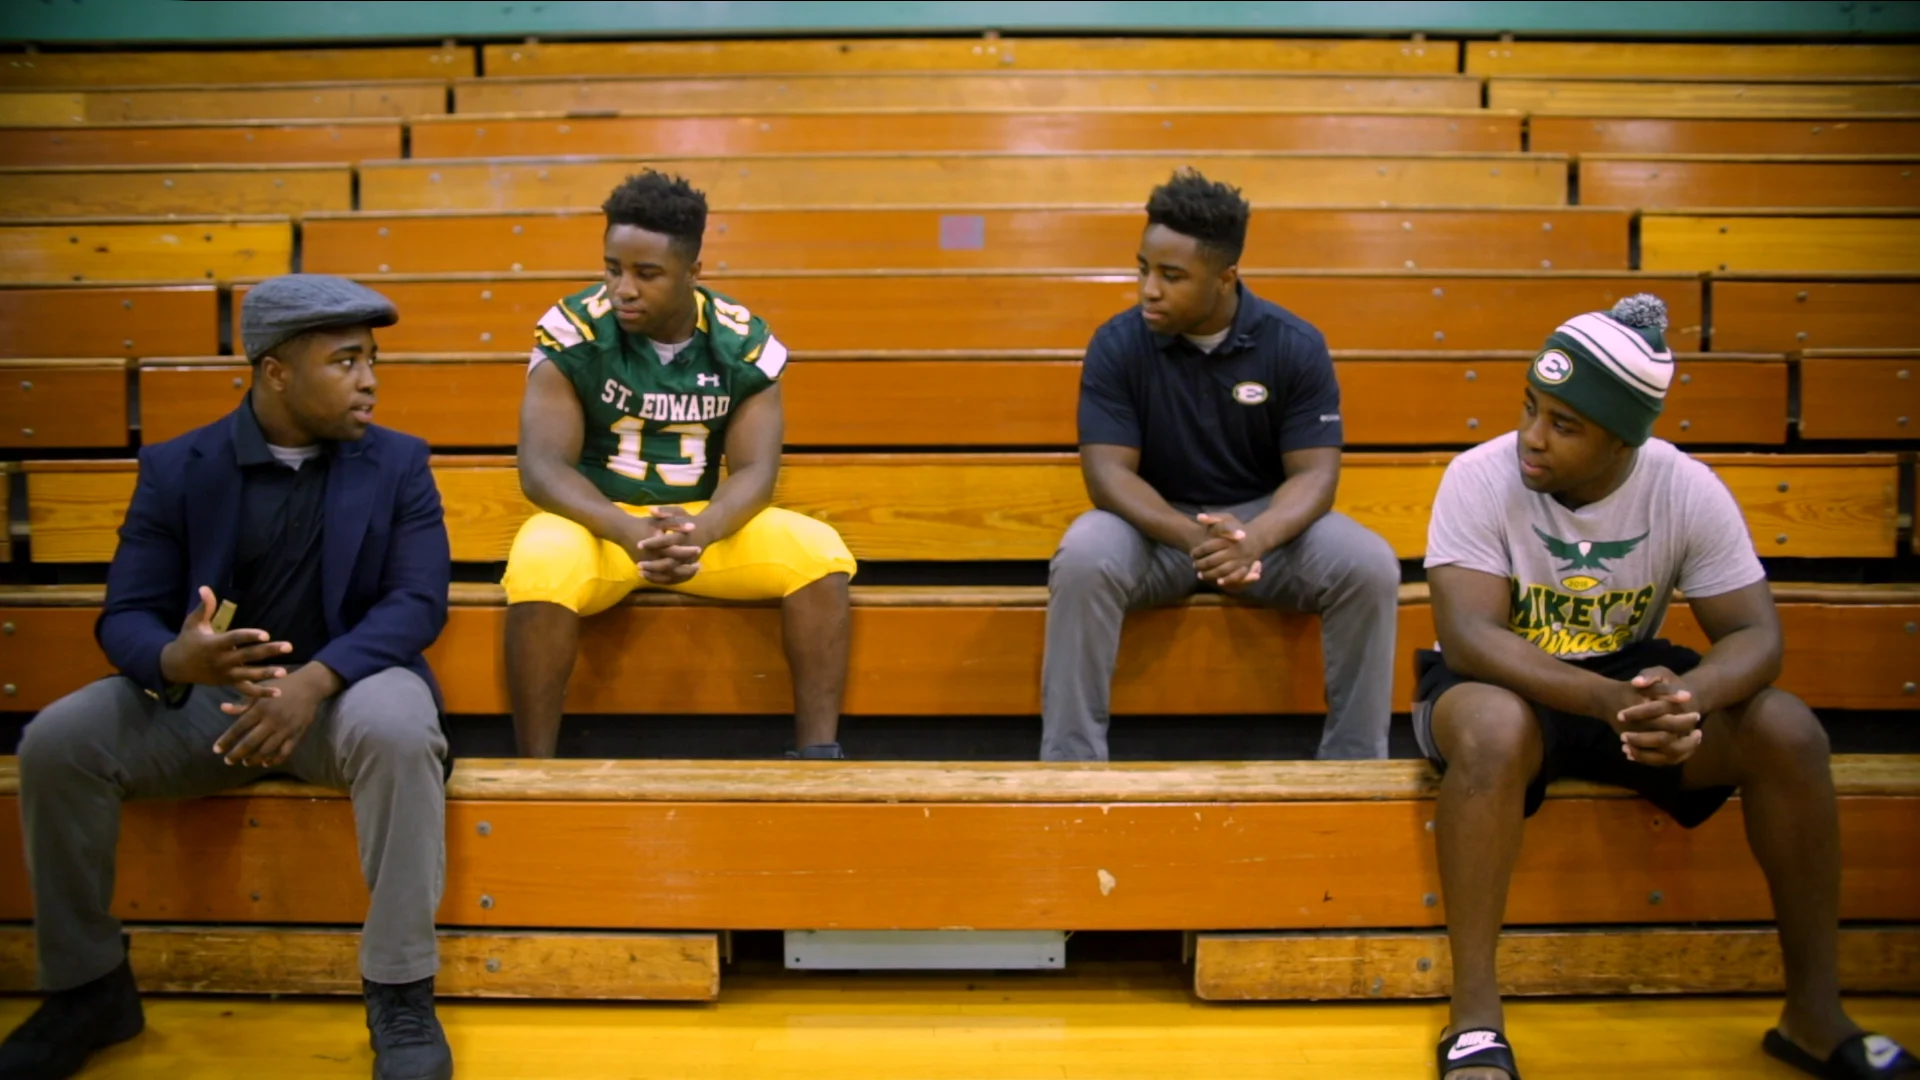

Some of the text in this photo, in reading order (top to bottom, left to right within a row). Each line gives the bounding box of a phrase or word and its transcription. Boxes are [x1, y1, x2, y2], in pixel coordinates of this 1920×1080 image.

[713, 297, 750, 336] 13
[601, 378, 731, 422] ST. EDWARD
[606, 415, 710, 487] 13
[1510, 574, 1656, 630] MIKEY'S
[1455, 1030, 1497, 1050] NIKE
